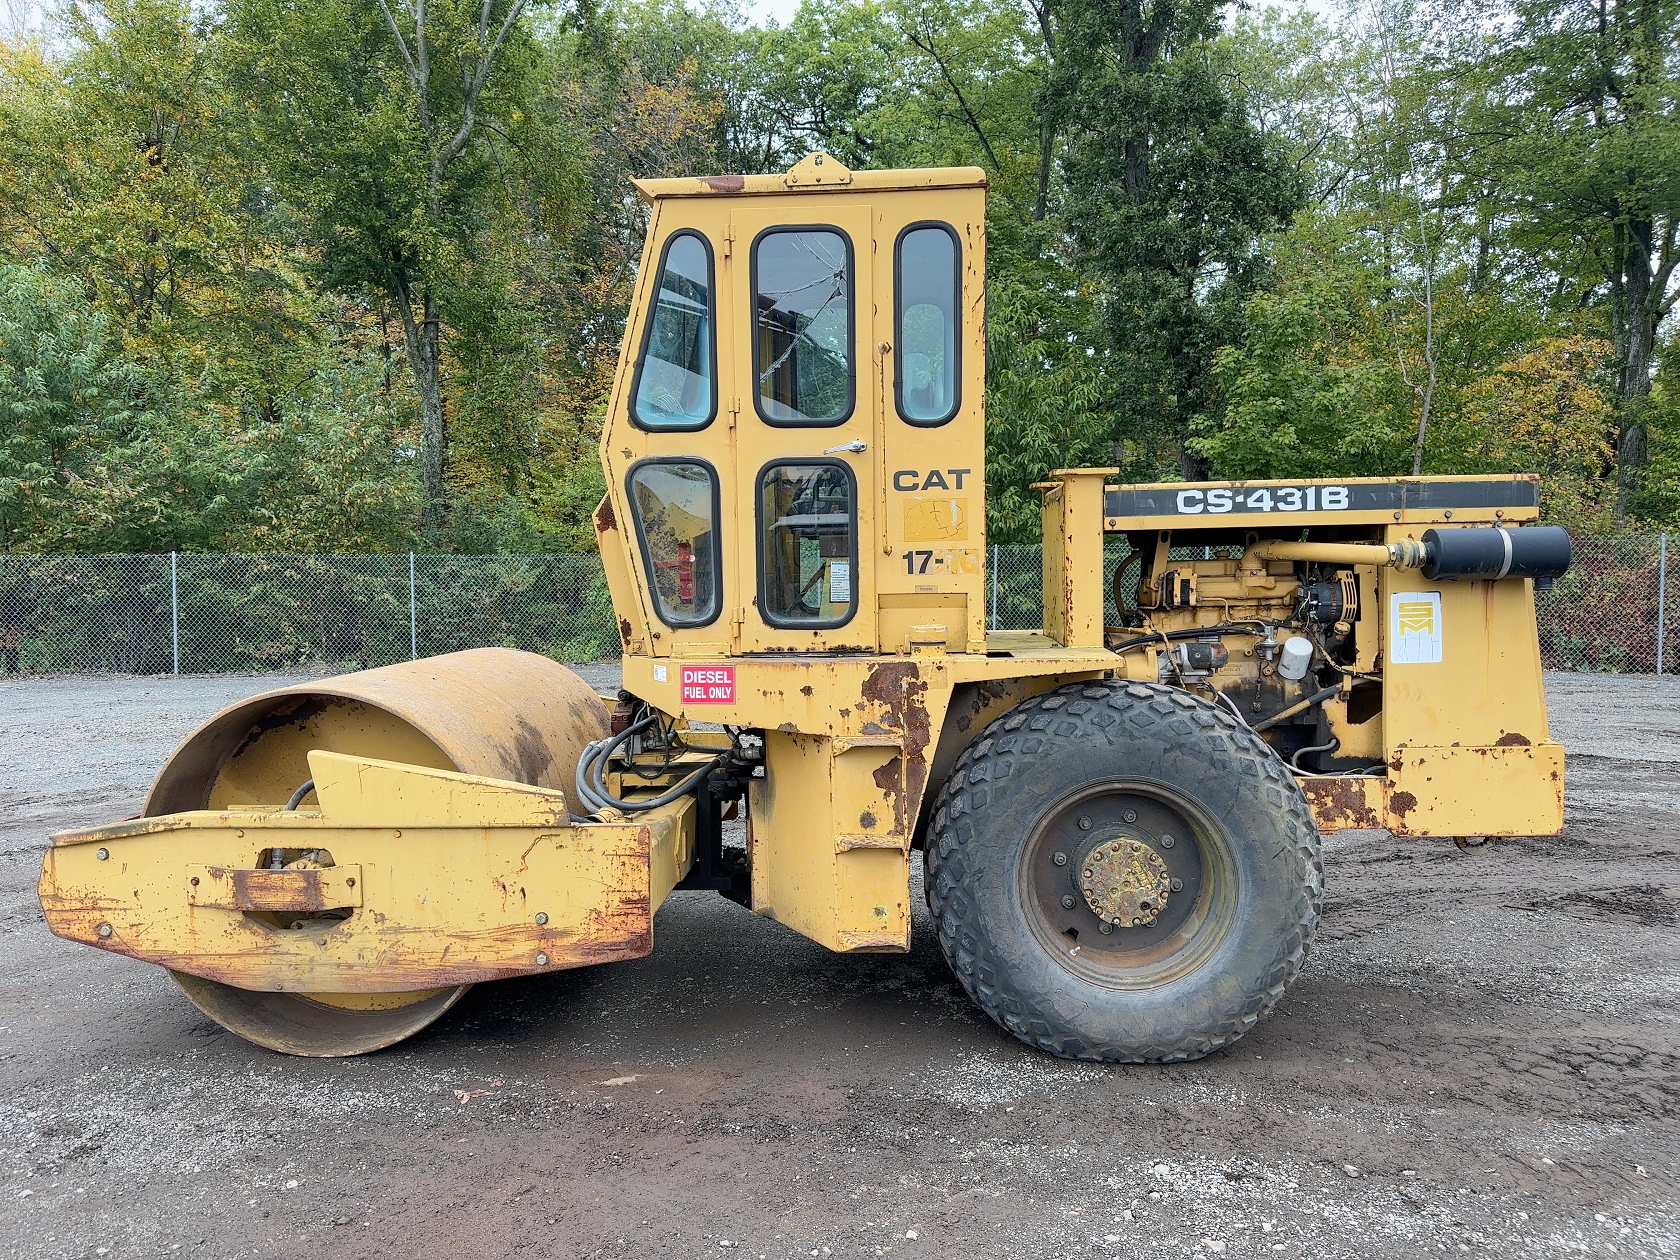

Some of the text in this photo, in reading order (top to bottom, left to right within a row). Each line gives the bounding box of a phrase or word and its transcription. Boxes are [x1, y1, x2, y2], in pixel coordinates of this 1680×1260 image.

[893, 469, 971, 492] CAT
[1176, 486, 1349, 514] CS-431B
[684, 670, 732, 684] DIESEL
[684, 686, 732, 699] FUEL ONLY
